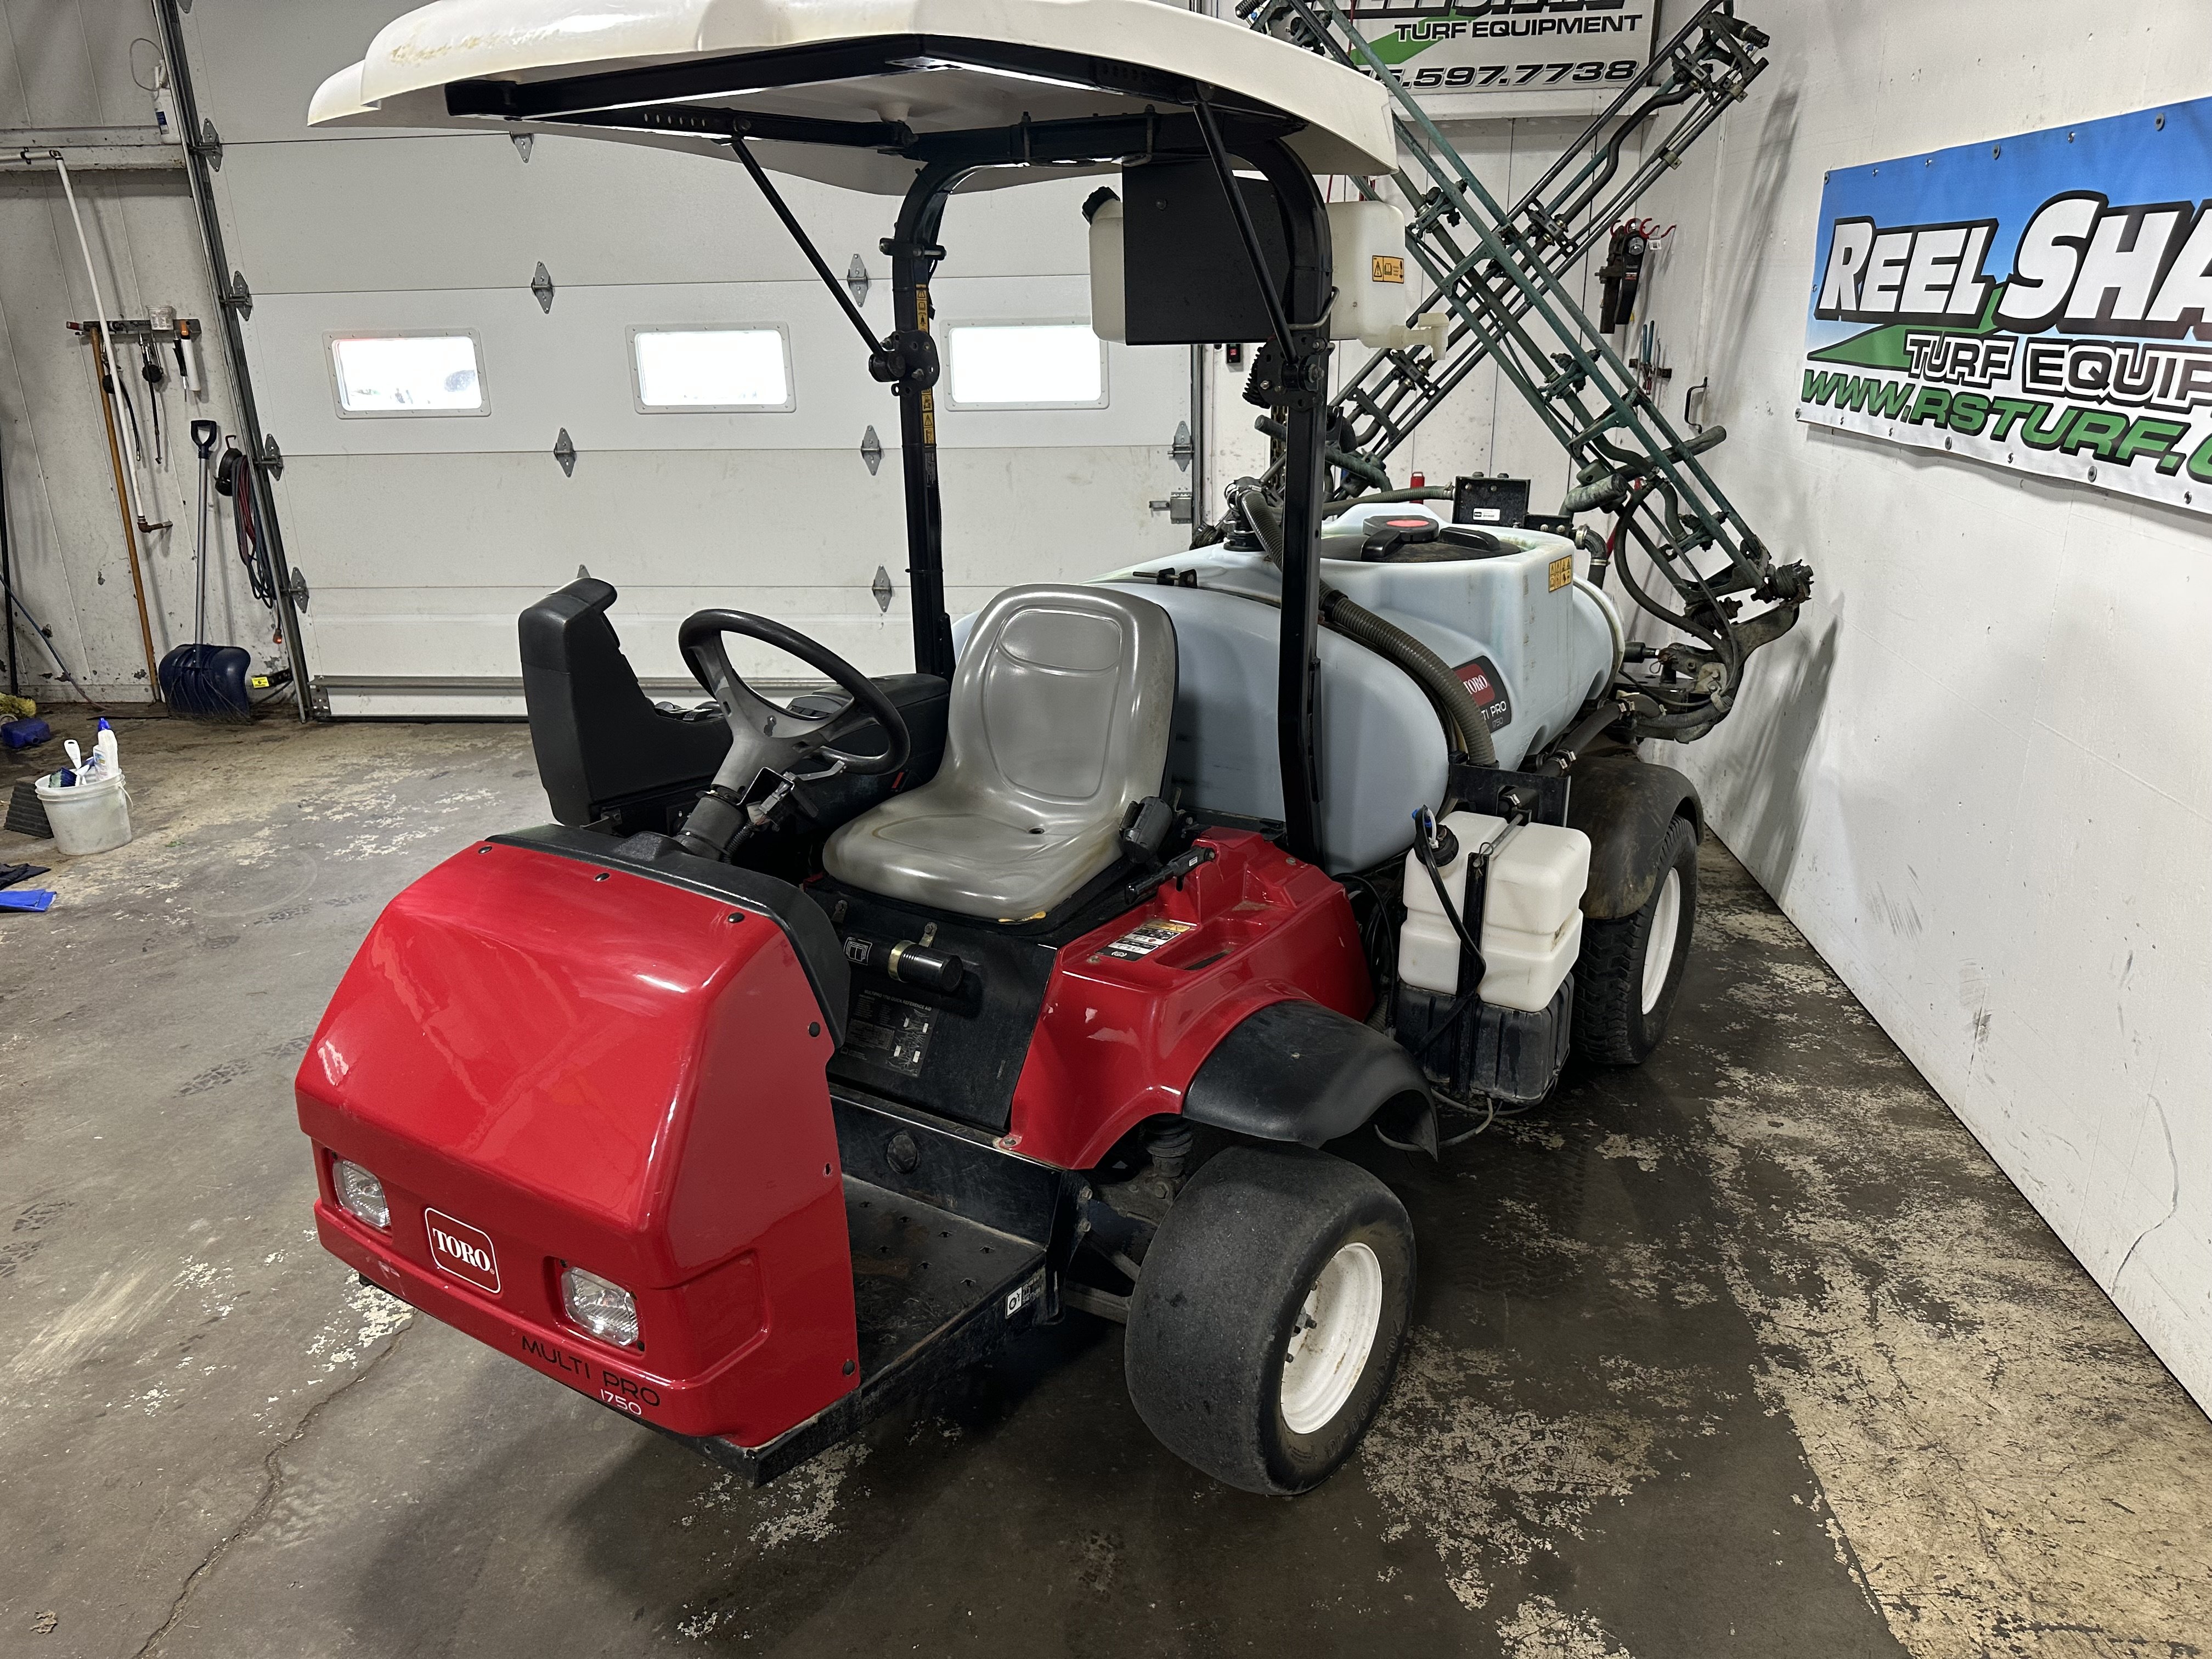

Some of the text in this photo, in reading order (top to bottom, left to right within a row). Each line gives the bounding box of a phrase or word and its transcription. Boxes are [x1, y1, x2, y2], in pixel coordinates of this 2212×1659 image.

[1393, 14, 1643, 42] TURF EQUIPMENT
[1361, 60, 1637, 89] .597.7738
[1816, 218, 1993, 321] REEL
[1906, 334, 2013, 386] TURF
[1463, 675, 1488, 695] TORO
[1489, 701, 1507, 717] PRO
[1492, 716, 1504, 729] 1750
[432, 1227, 491, 1272] TORO
[522, 1335, 661, 1407] MULTI PRO
[600, 1388, 642, 1415] 1750
